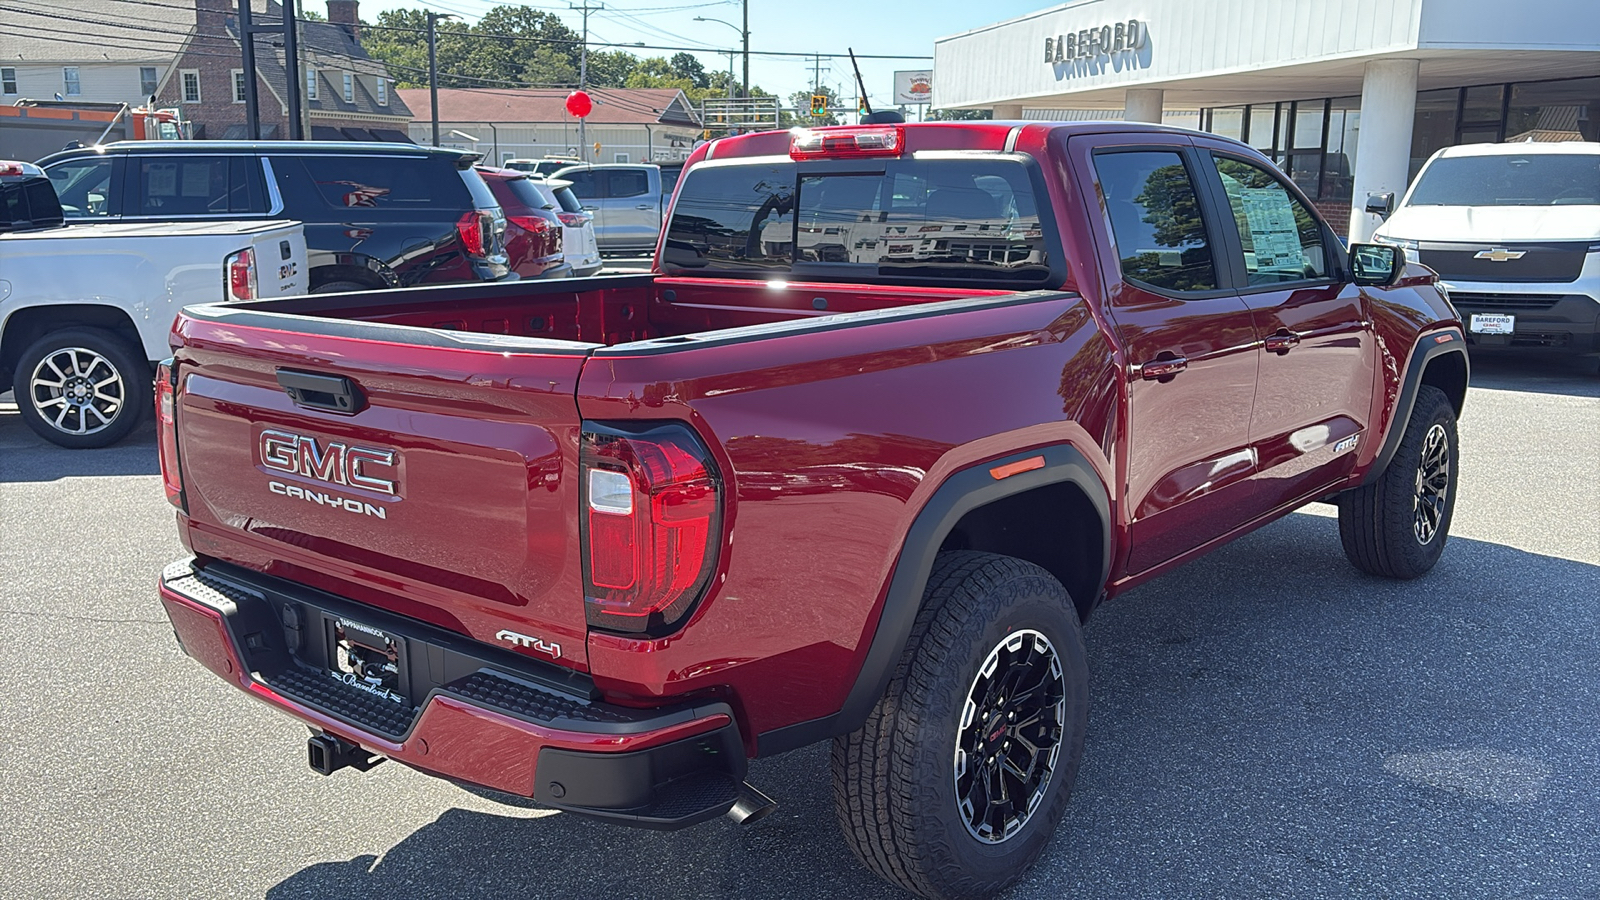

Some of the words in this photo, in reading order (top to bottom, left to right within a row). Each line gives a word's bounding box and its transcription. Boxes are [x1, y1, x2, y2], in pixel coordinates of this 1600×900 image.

[1044, 19, 1139, 64] BAREFORD
[279, 262, 297, 280] GMC
[1475, 316, 1511, 324] BAREFORD
[260, 429, 395, 495] GMC
[269, 481, 387, 520] CANYON
[339, 617, 385, 638] TAPPAHANNOCK
[495, 629, 563, 660] AT4
[989, 722, 1007, 742] GMC
